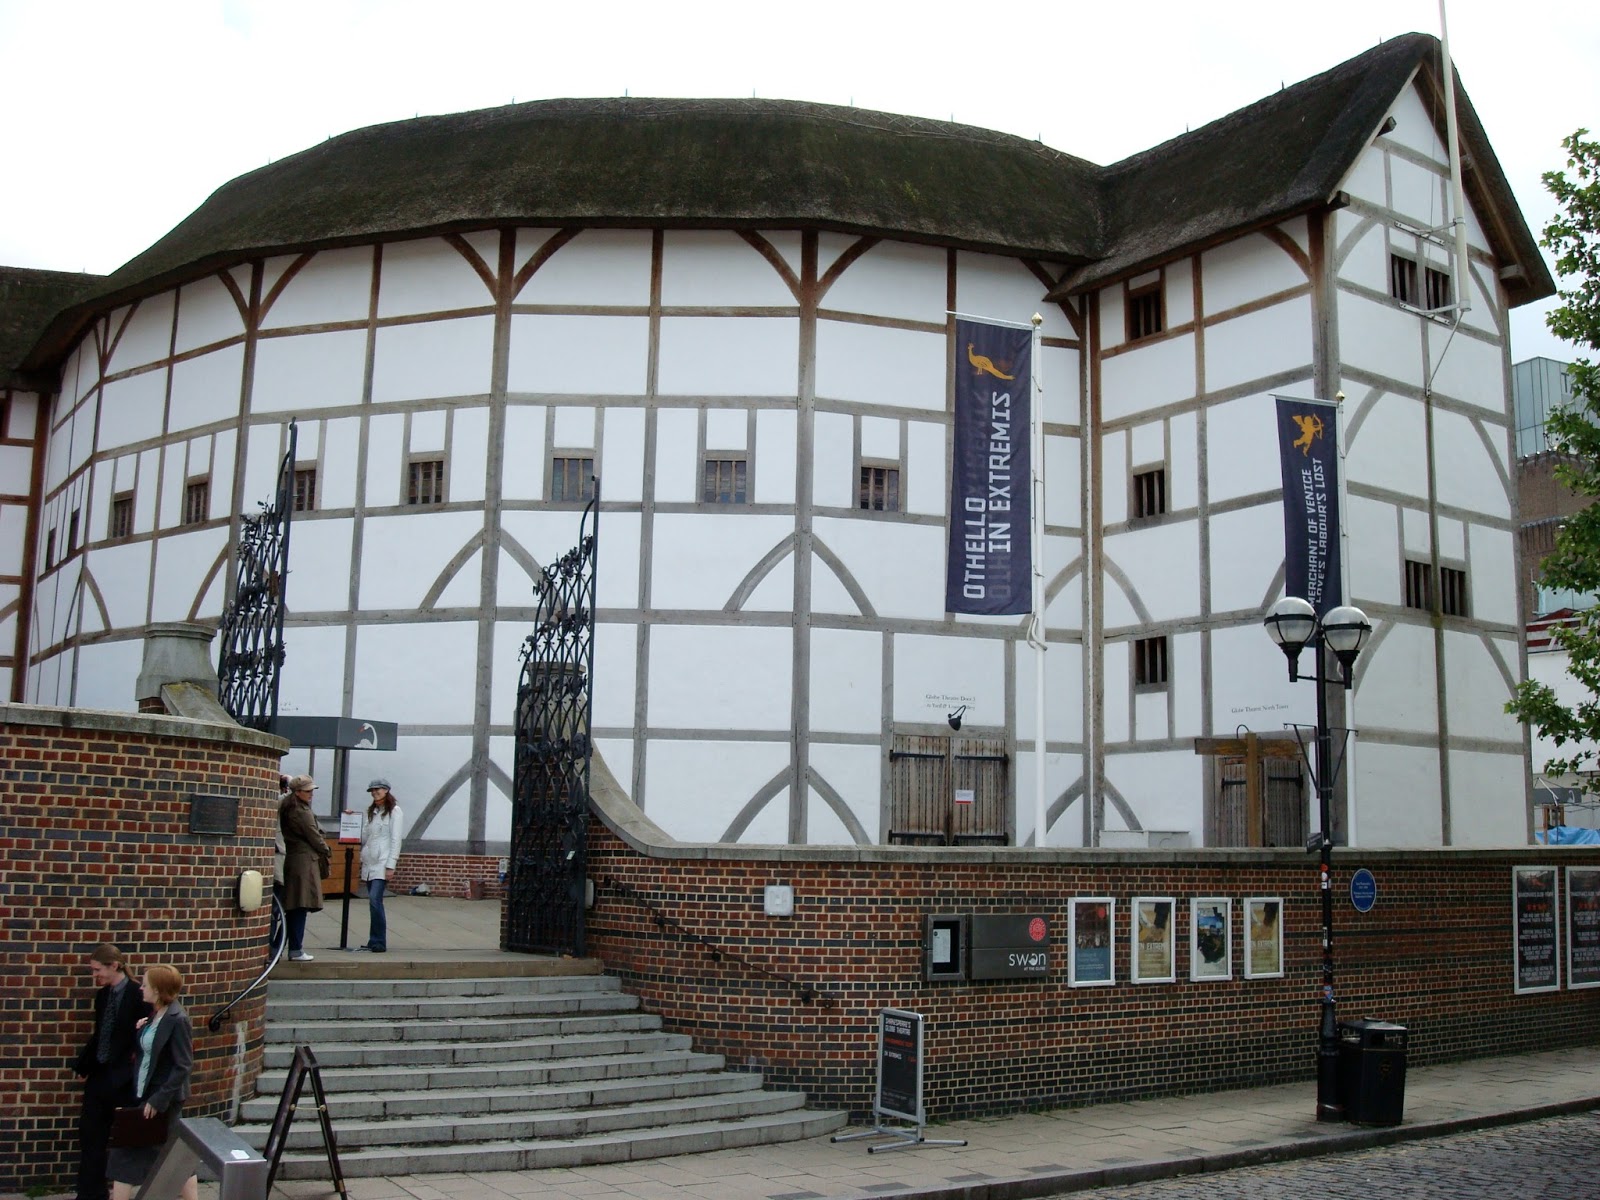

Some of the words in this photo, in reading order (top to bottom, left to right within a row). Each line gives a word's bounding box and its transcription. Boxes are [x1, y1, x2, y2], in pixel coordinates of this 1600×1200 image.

[988, 391, 1011, 511] EXTREMIS
[1312, 457, 1326, 488] LOST
[1301, 468, 1316, 514] VENICE
[988, 522, 1011, 553] IN
[1307, 518, 1318, 534] OF
[1316, 492, 1328, 556] LABOUR'S
[963, 496, 986, 599] OTHELLO
[1307, 538, 1318, 608] MERCHANT
[1315, 560, 1326, 604] LOVE'S
[1008, 953, 1046, 966] swan
